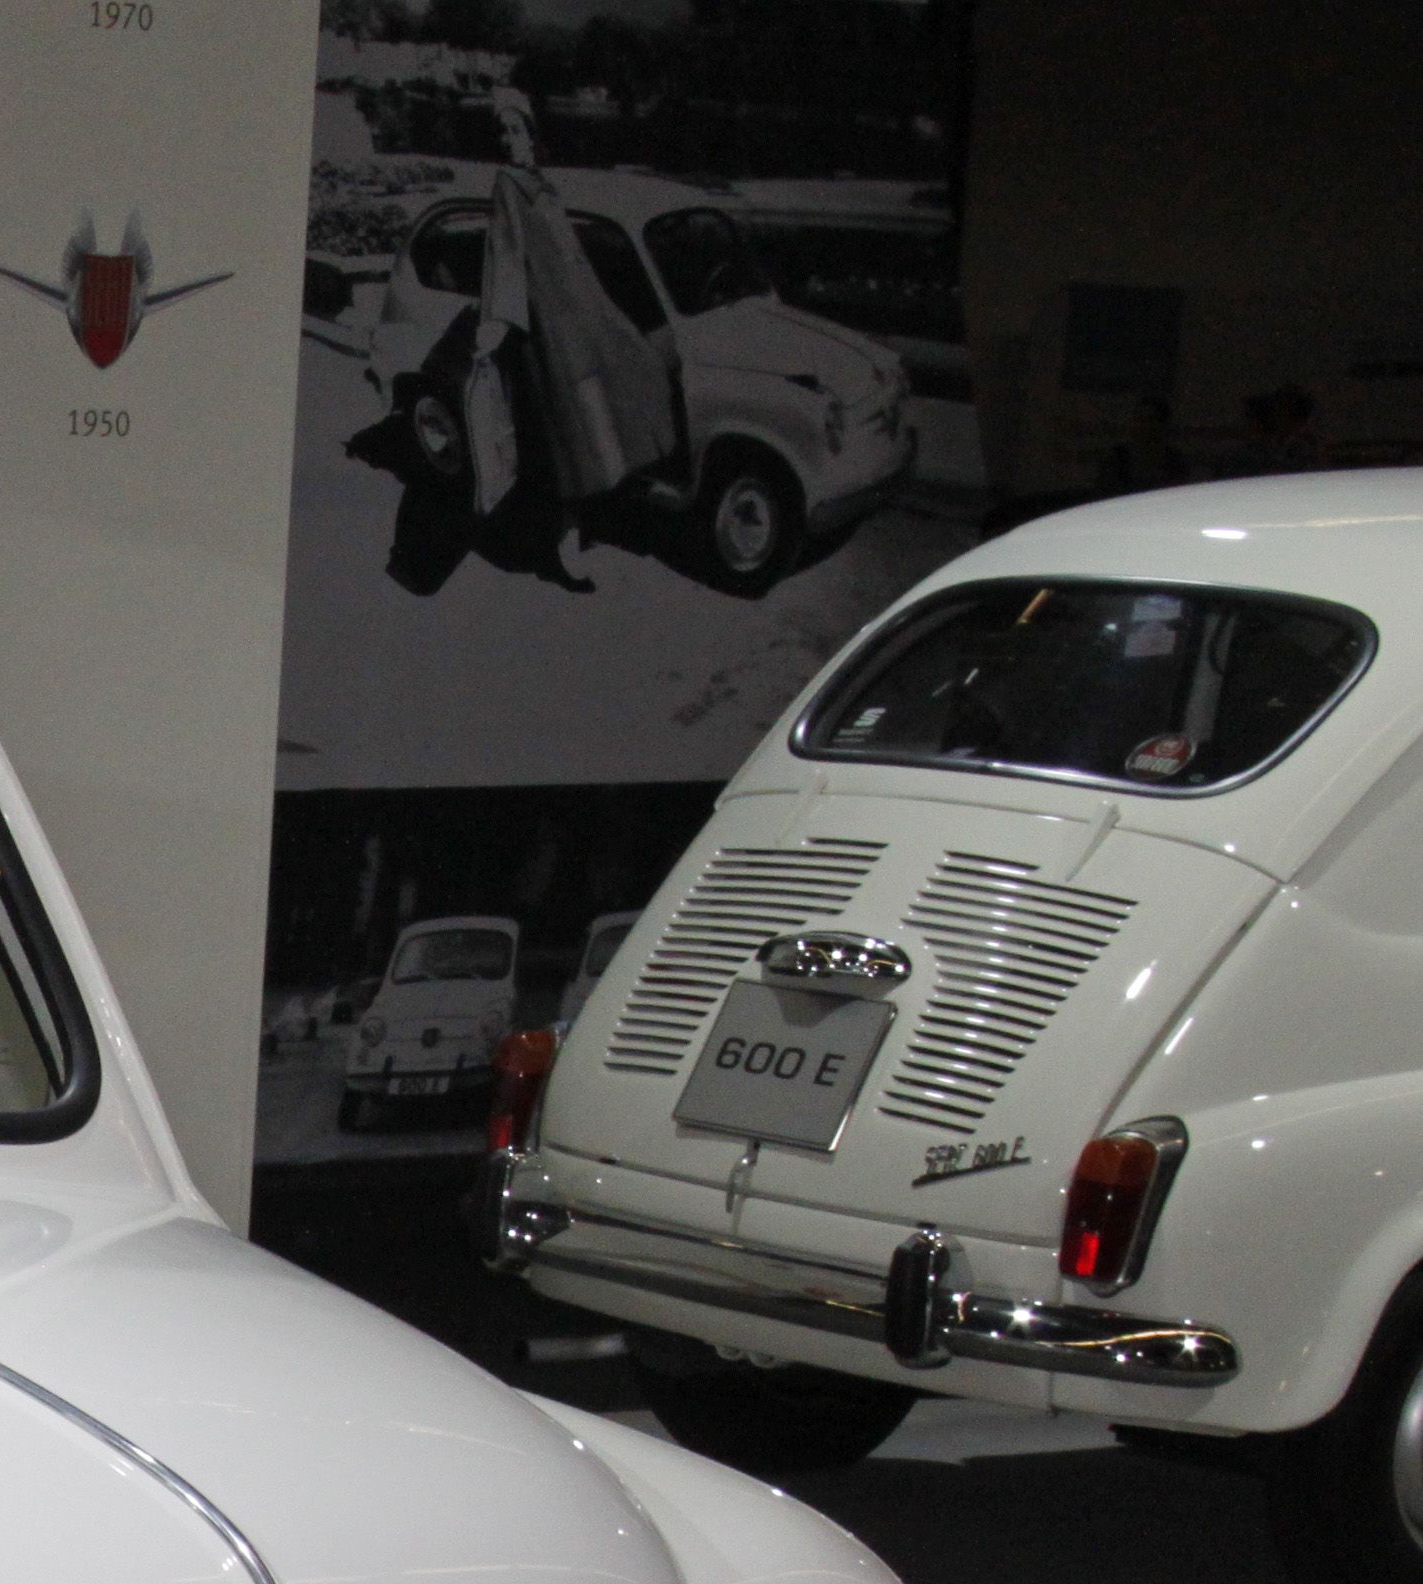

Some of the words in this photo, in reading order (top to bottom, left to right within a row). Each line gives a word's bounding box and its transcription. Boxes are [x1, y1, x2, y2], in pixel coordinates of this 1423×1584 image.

[91, 1, 153, 31] 1970
[68, 409, 130, 437] 1950
[715, 1036, 807, 1080] 600
[813, 1052, 846, 1087] E
